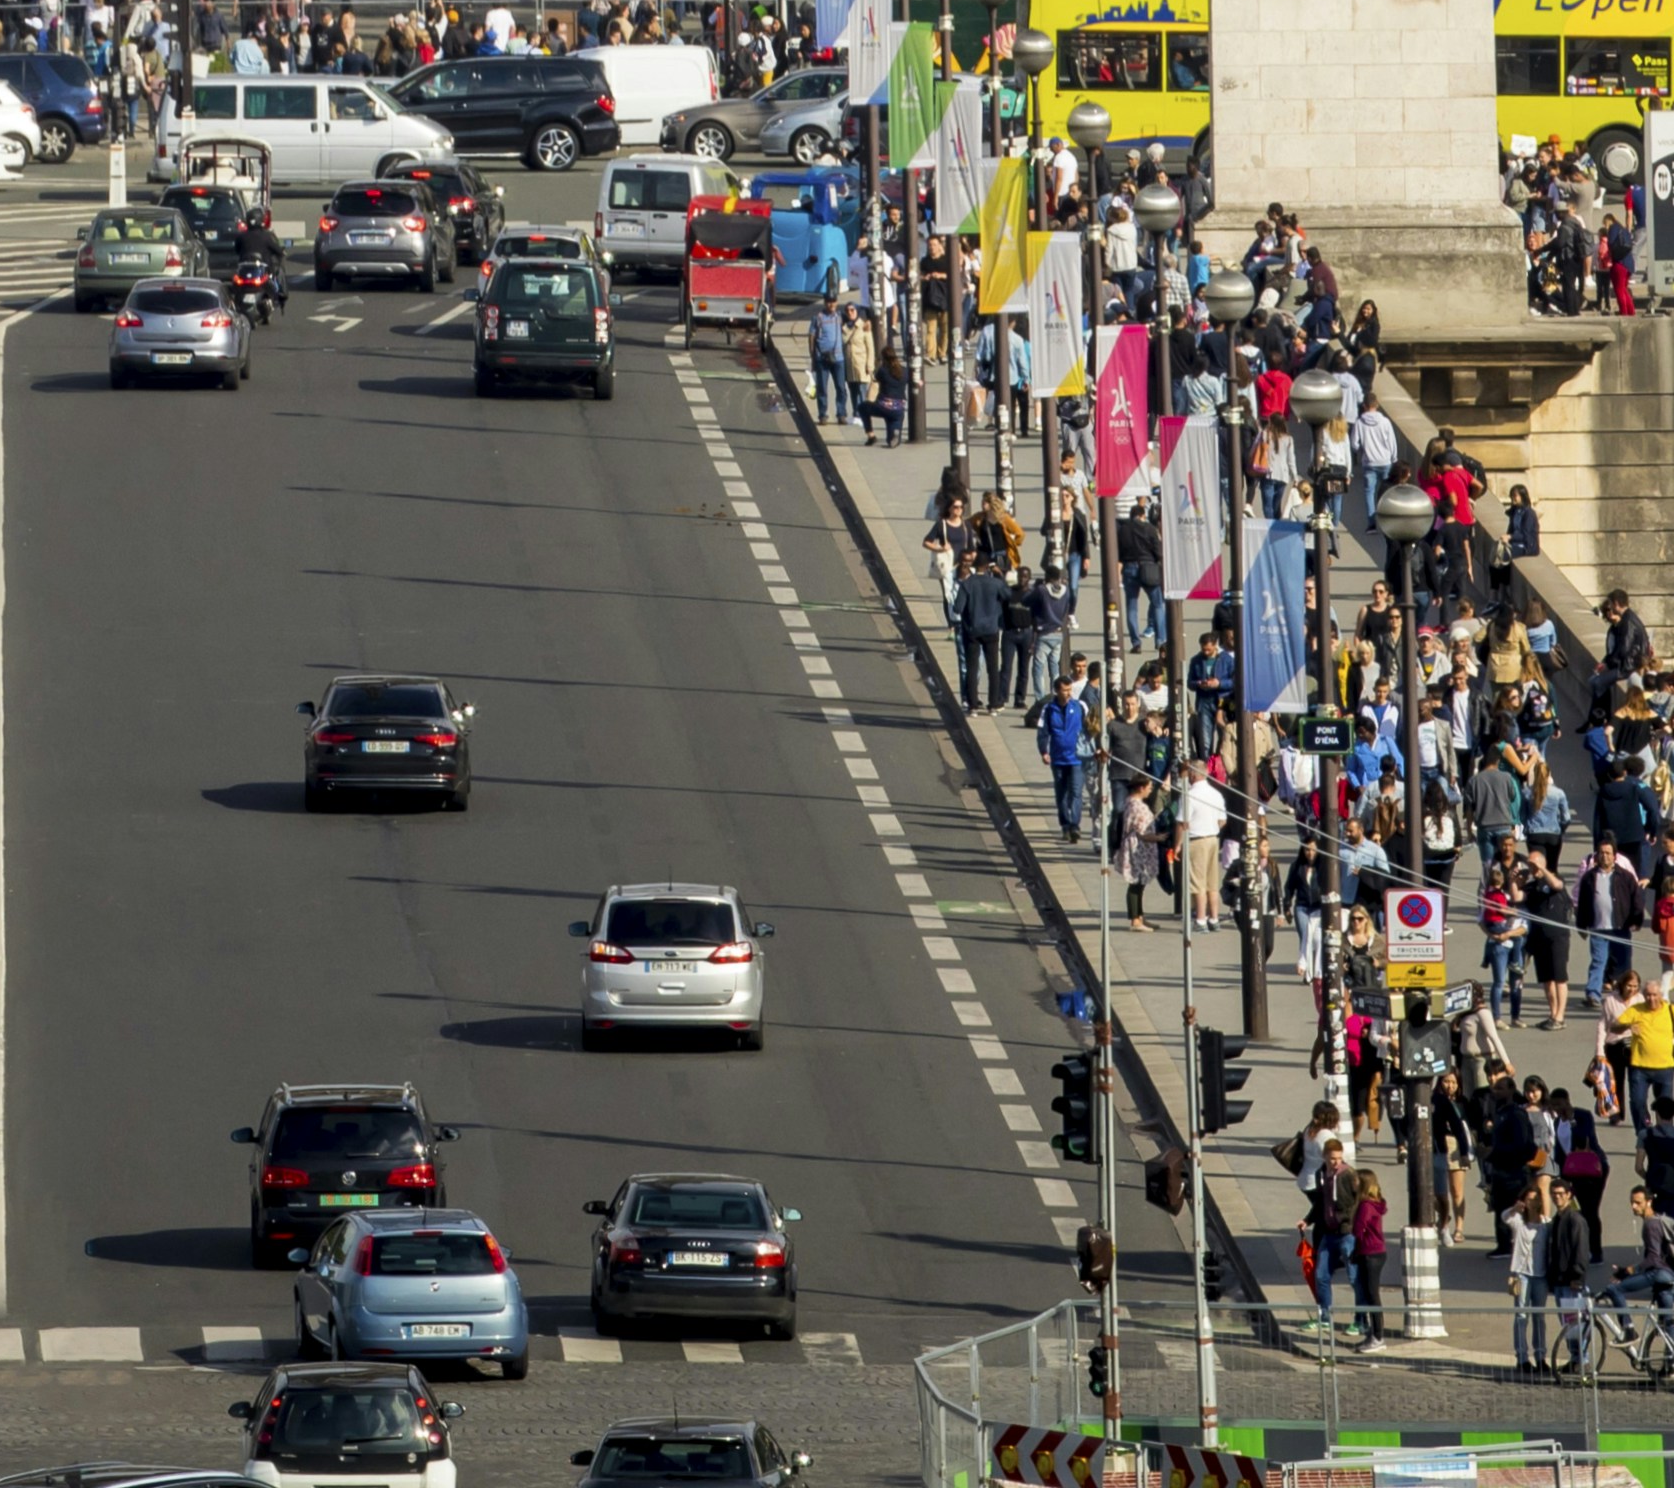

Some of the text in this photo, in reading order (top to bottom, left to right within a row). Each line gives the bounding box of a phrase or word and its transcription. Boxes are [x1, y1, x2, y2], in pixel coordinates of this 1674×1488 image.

[1644, 55, 1669, 65] Pass
[1109, 419, 1134, 428] PARIS
[1177, 517, 1204, 525] PARIS
[1259, 626, 1288, 634] PARIS
[1317, 726, 1337, 736] PONT
[1315, 736, 1339, 745] D'IÉNA
